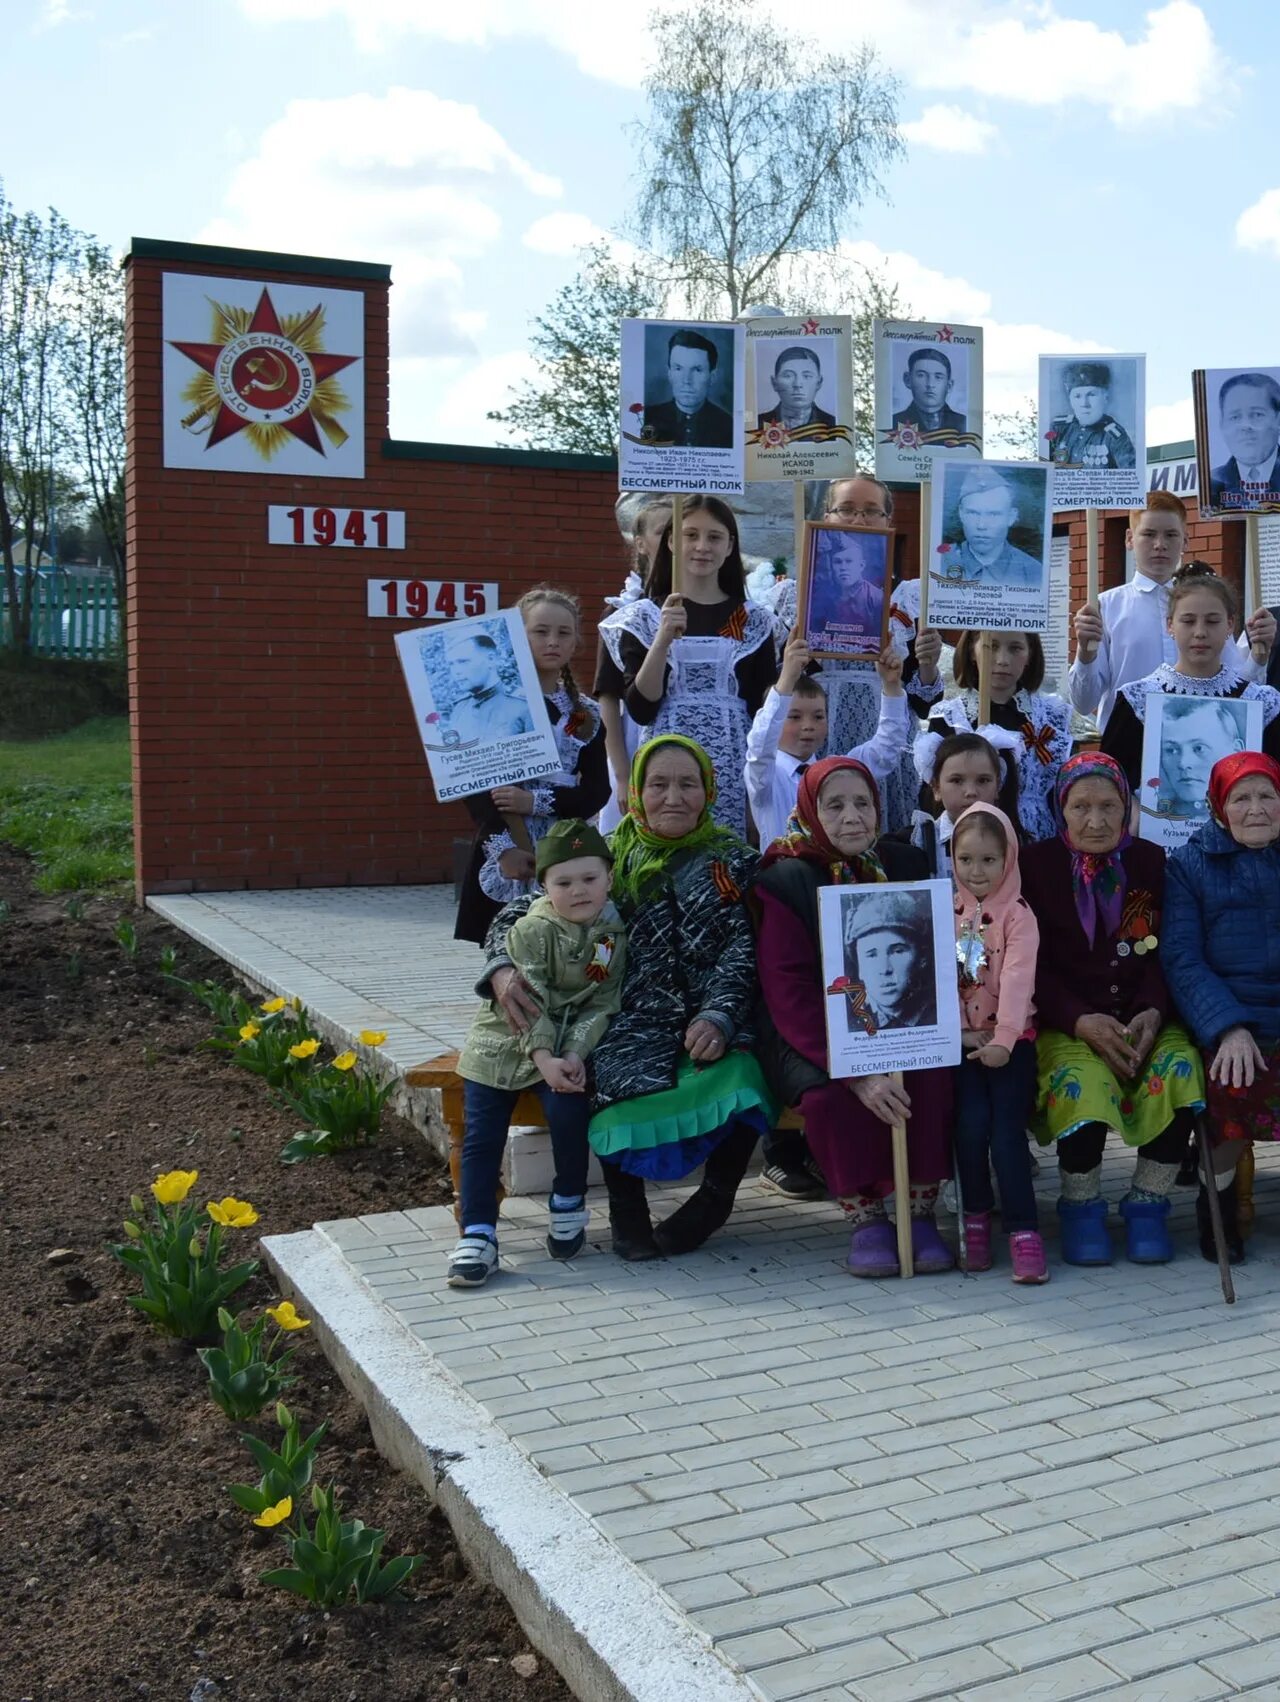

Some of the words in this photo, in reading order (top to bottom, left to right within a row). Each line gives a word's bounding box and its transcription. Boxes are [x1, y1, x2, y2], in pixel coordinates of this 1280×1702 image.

[220, 336, 304, 413] ОТЕЧЕСТВЕННАЯ
[284, 368, 312, 415] ВОЙНА
[622, 477, 706, 489] БЕССМЕРТНЫЙ
[710, 481, 742, 490] ПОЛК
[288, 508, 388, 547] 1941
[381, 580, 486, 617] 1945
[929, 615, 1011, 627] БЕССМЕРТНЫЙ
[1015, 619, 1046, 629] ПОЛК
[439, 769, 525, 798] БЕССМЕРТНЫЙ
[528, 761, 561, 776] ПОЛК
[851, 1057, 917, 1073] БЕССМЕРТНЫЙ
[919, 1055, 943, 1065] ПОЛК
